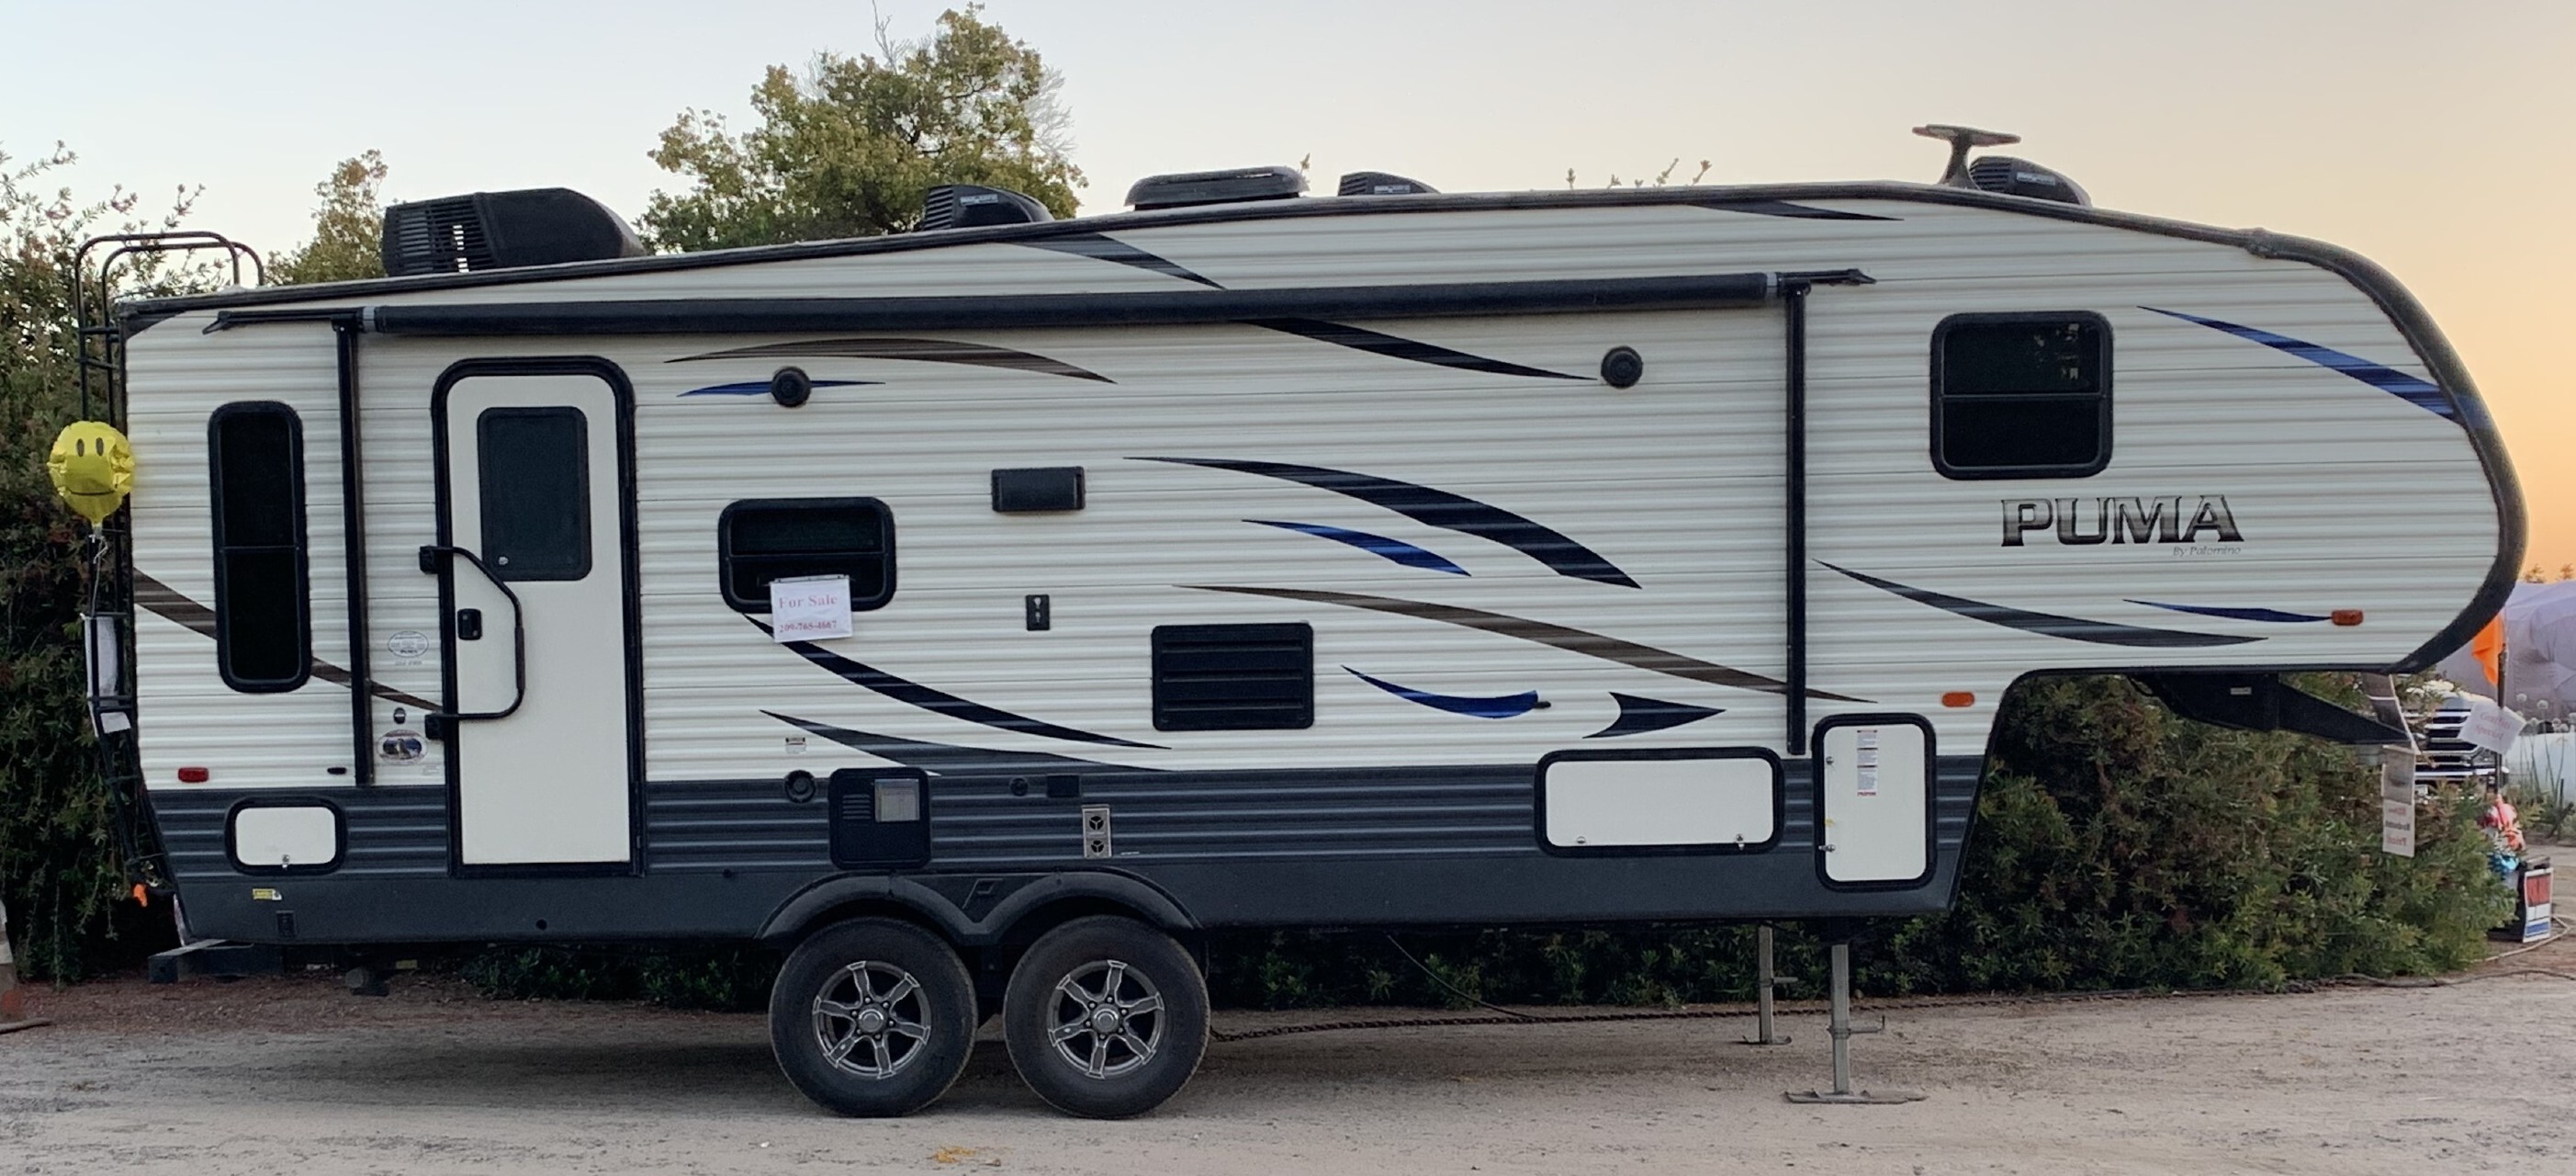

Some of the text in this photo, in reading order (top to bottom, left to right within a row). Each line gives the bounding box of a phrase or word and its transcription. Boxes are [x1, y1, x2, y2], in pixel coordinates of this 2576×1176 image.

[2001, 494, 2244, 547] PUMA
[2190, 546, 2241, 556] Palomino
[779, 594, 838, 609] For Sale
